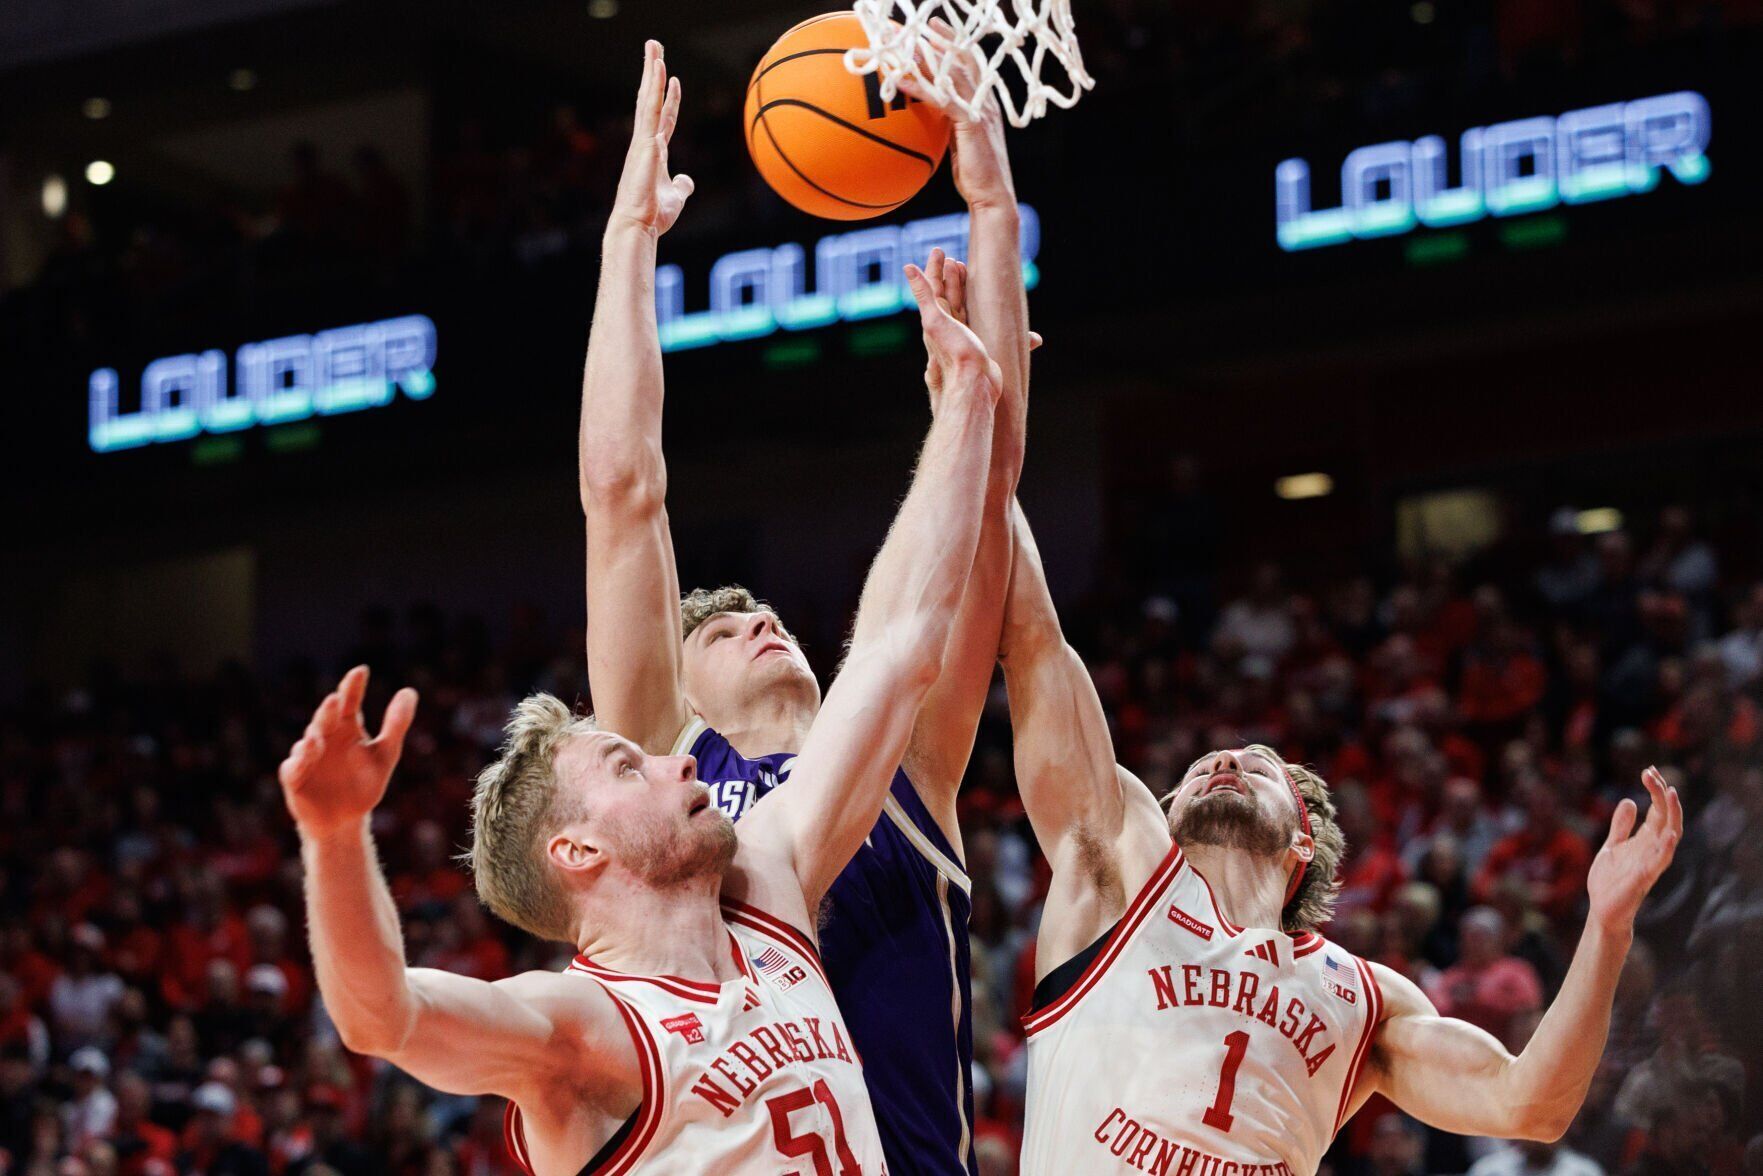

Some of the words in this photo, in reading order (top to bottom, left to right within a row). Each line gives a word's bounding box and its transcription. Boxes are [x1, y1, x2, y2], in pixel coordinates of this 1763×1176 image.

[1276, 91, 1711, 252] LOUDER
[89, 313, 437, 453] LOUDER
[1171, 909, 1212, 937] GRADUATE
[1147, 964, 1336, 1078] NEBRASKA
[765, 1078, 863, 1176] 51
[1201, 1029, 1251, 1133] 1
